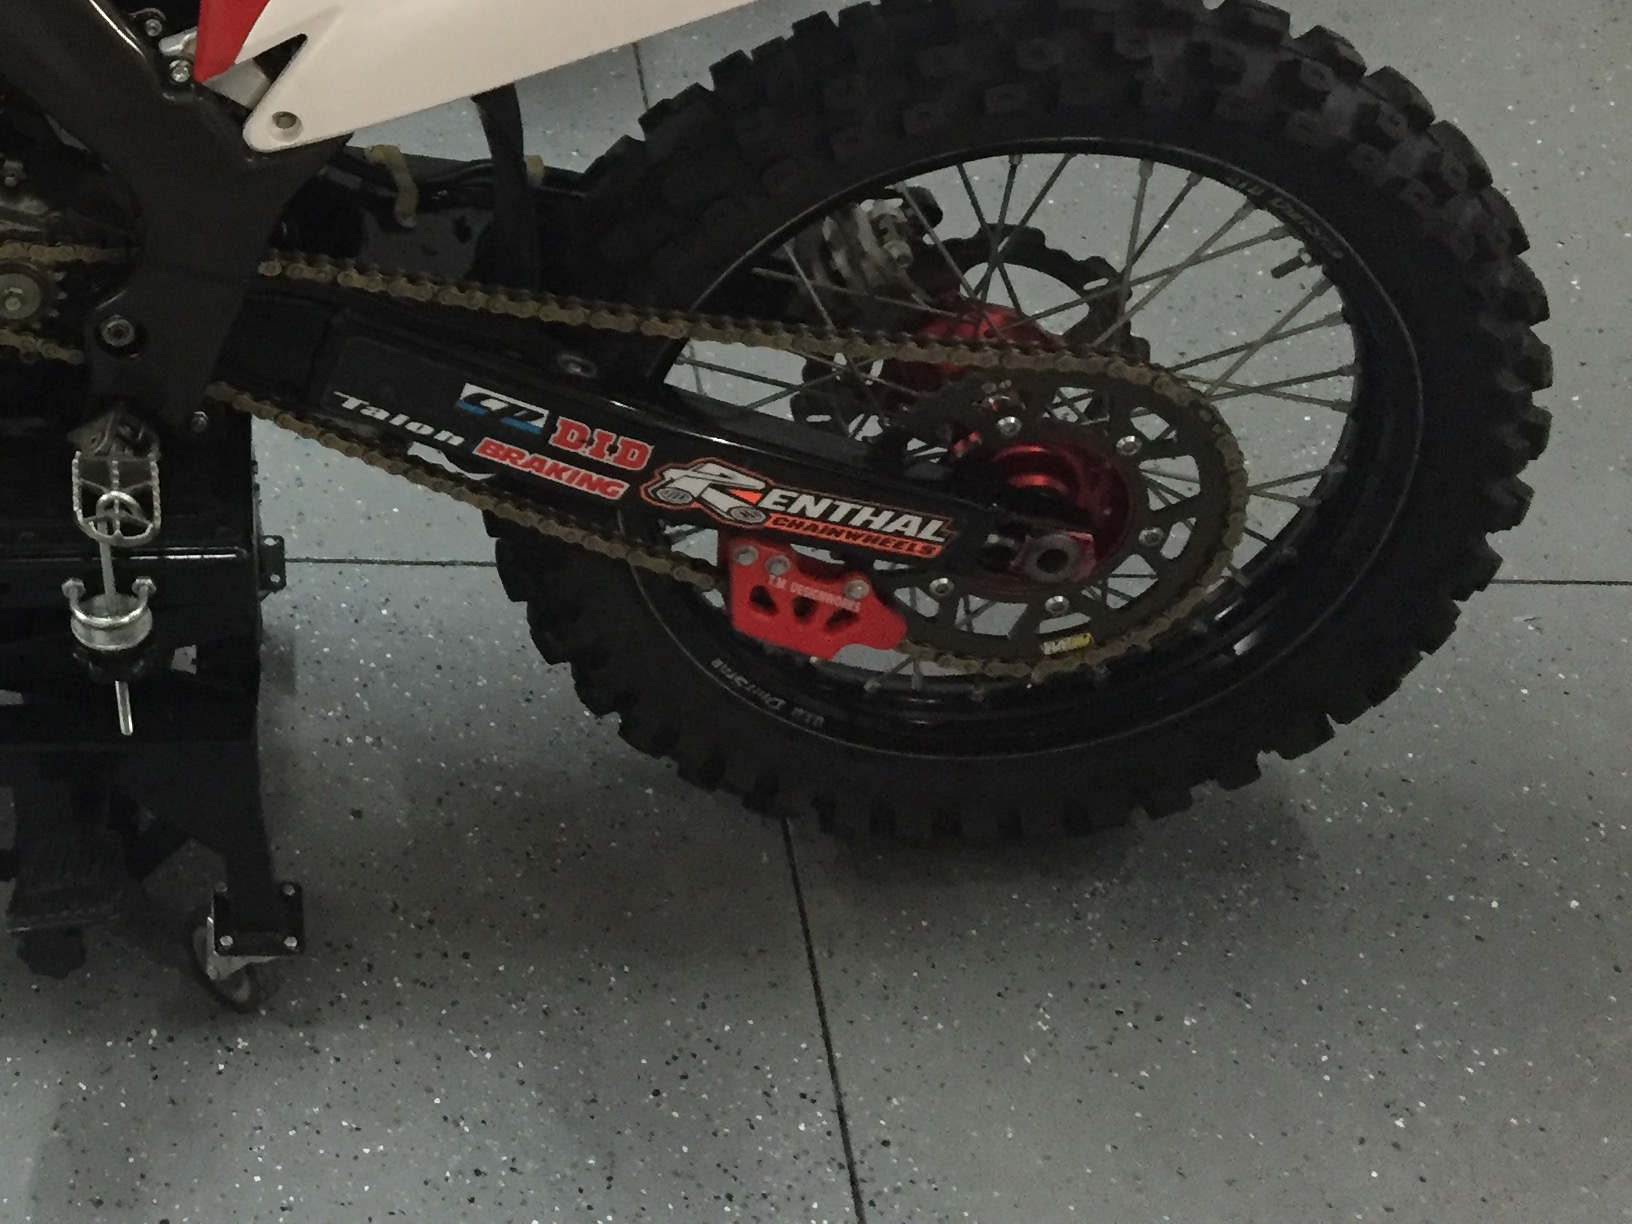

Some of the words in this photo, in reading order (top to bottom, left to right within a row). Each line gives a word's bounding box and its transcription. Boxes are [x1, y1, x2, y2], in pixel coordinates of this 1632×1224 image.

[334, 390, 466, 447] Talon
[474, 438, 628, 499] BRAKING
[653, 462, 948, 543] RENTHAL
[770, 516, 938, 556] CHAINWHEELS
